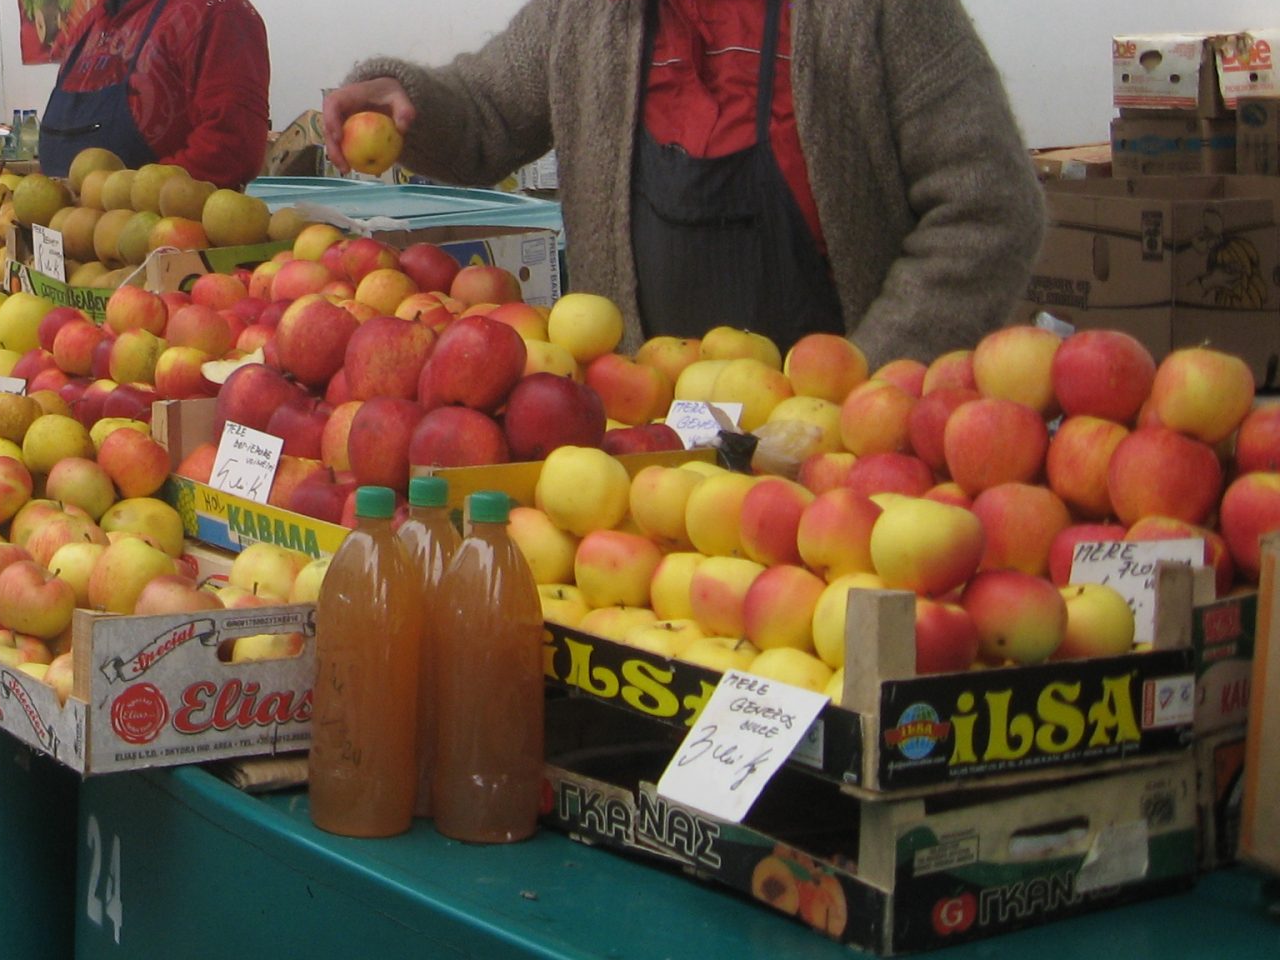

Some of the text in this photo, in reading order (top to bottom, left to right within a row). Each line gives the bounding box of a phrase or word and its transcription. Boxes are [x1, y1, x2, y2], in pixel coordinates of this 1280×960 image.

[1074, 544, 1138, 561] MERE
[132, 623, 196, 673] Special
[724, 673, 770, 696] MERE
[172, 677, 313, 735] Elias
[940, 898, 964, 927] G
